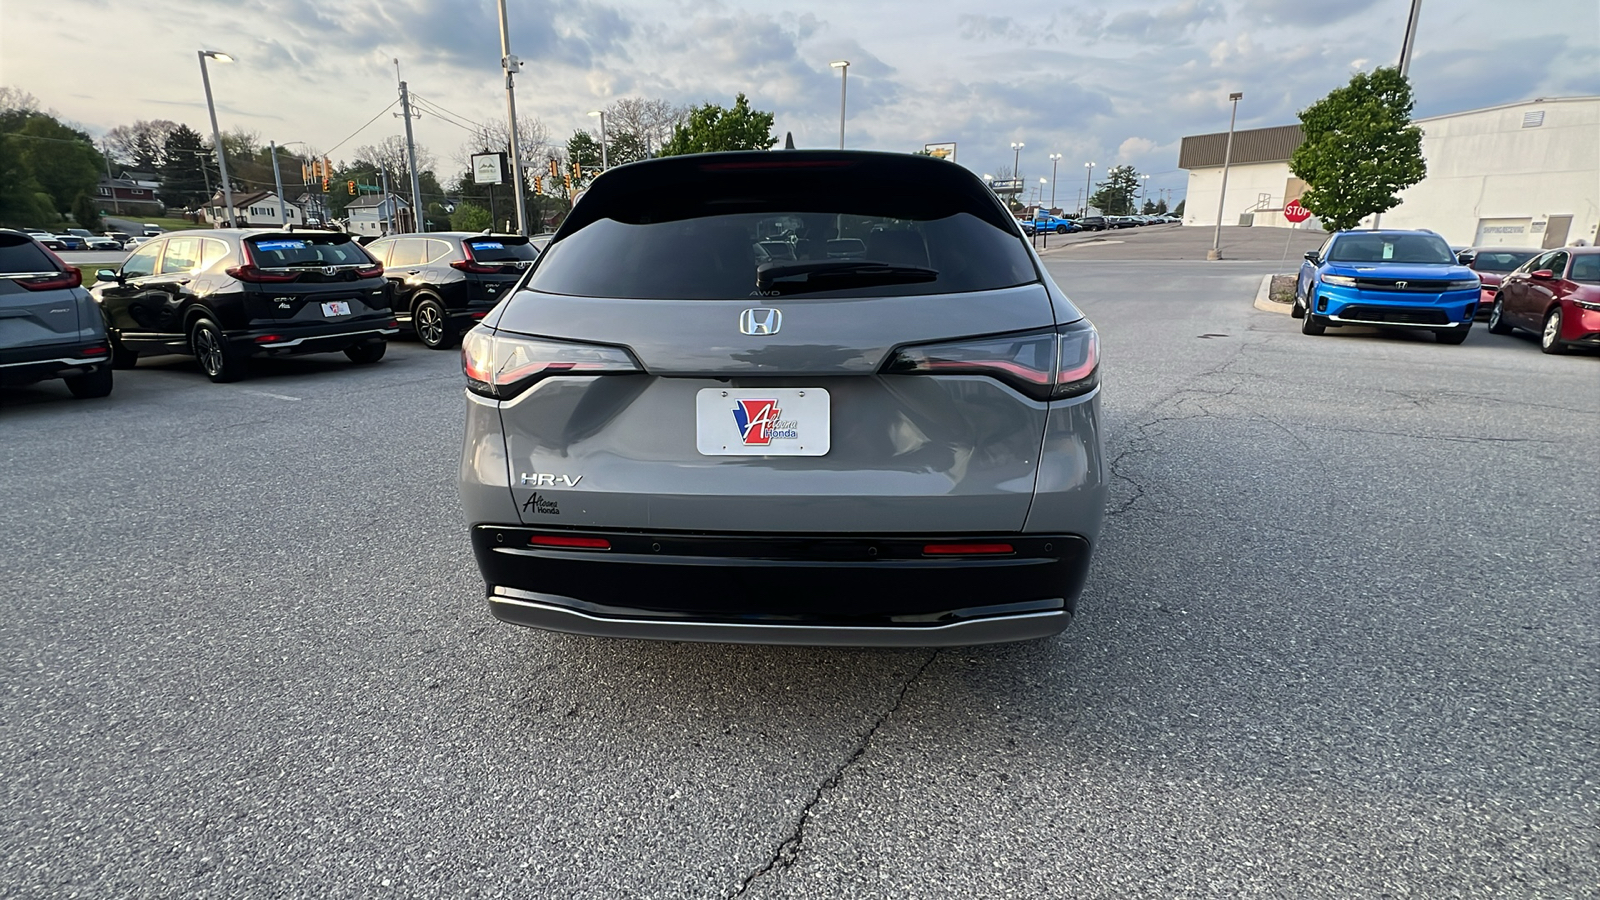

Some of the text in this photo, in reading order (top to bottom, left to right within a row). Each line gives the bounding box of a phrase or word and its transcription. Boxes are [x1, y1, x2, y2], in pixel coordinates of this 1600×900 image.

[1286, 206, 1310, 216] STOP
[744, 403, 798, 439] Altoona
[765, 429, 798, 438] Honda
[521, 472, 584, 487] HR-V
[523, 491, 558, 513] Altoona
